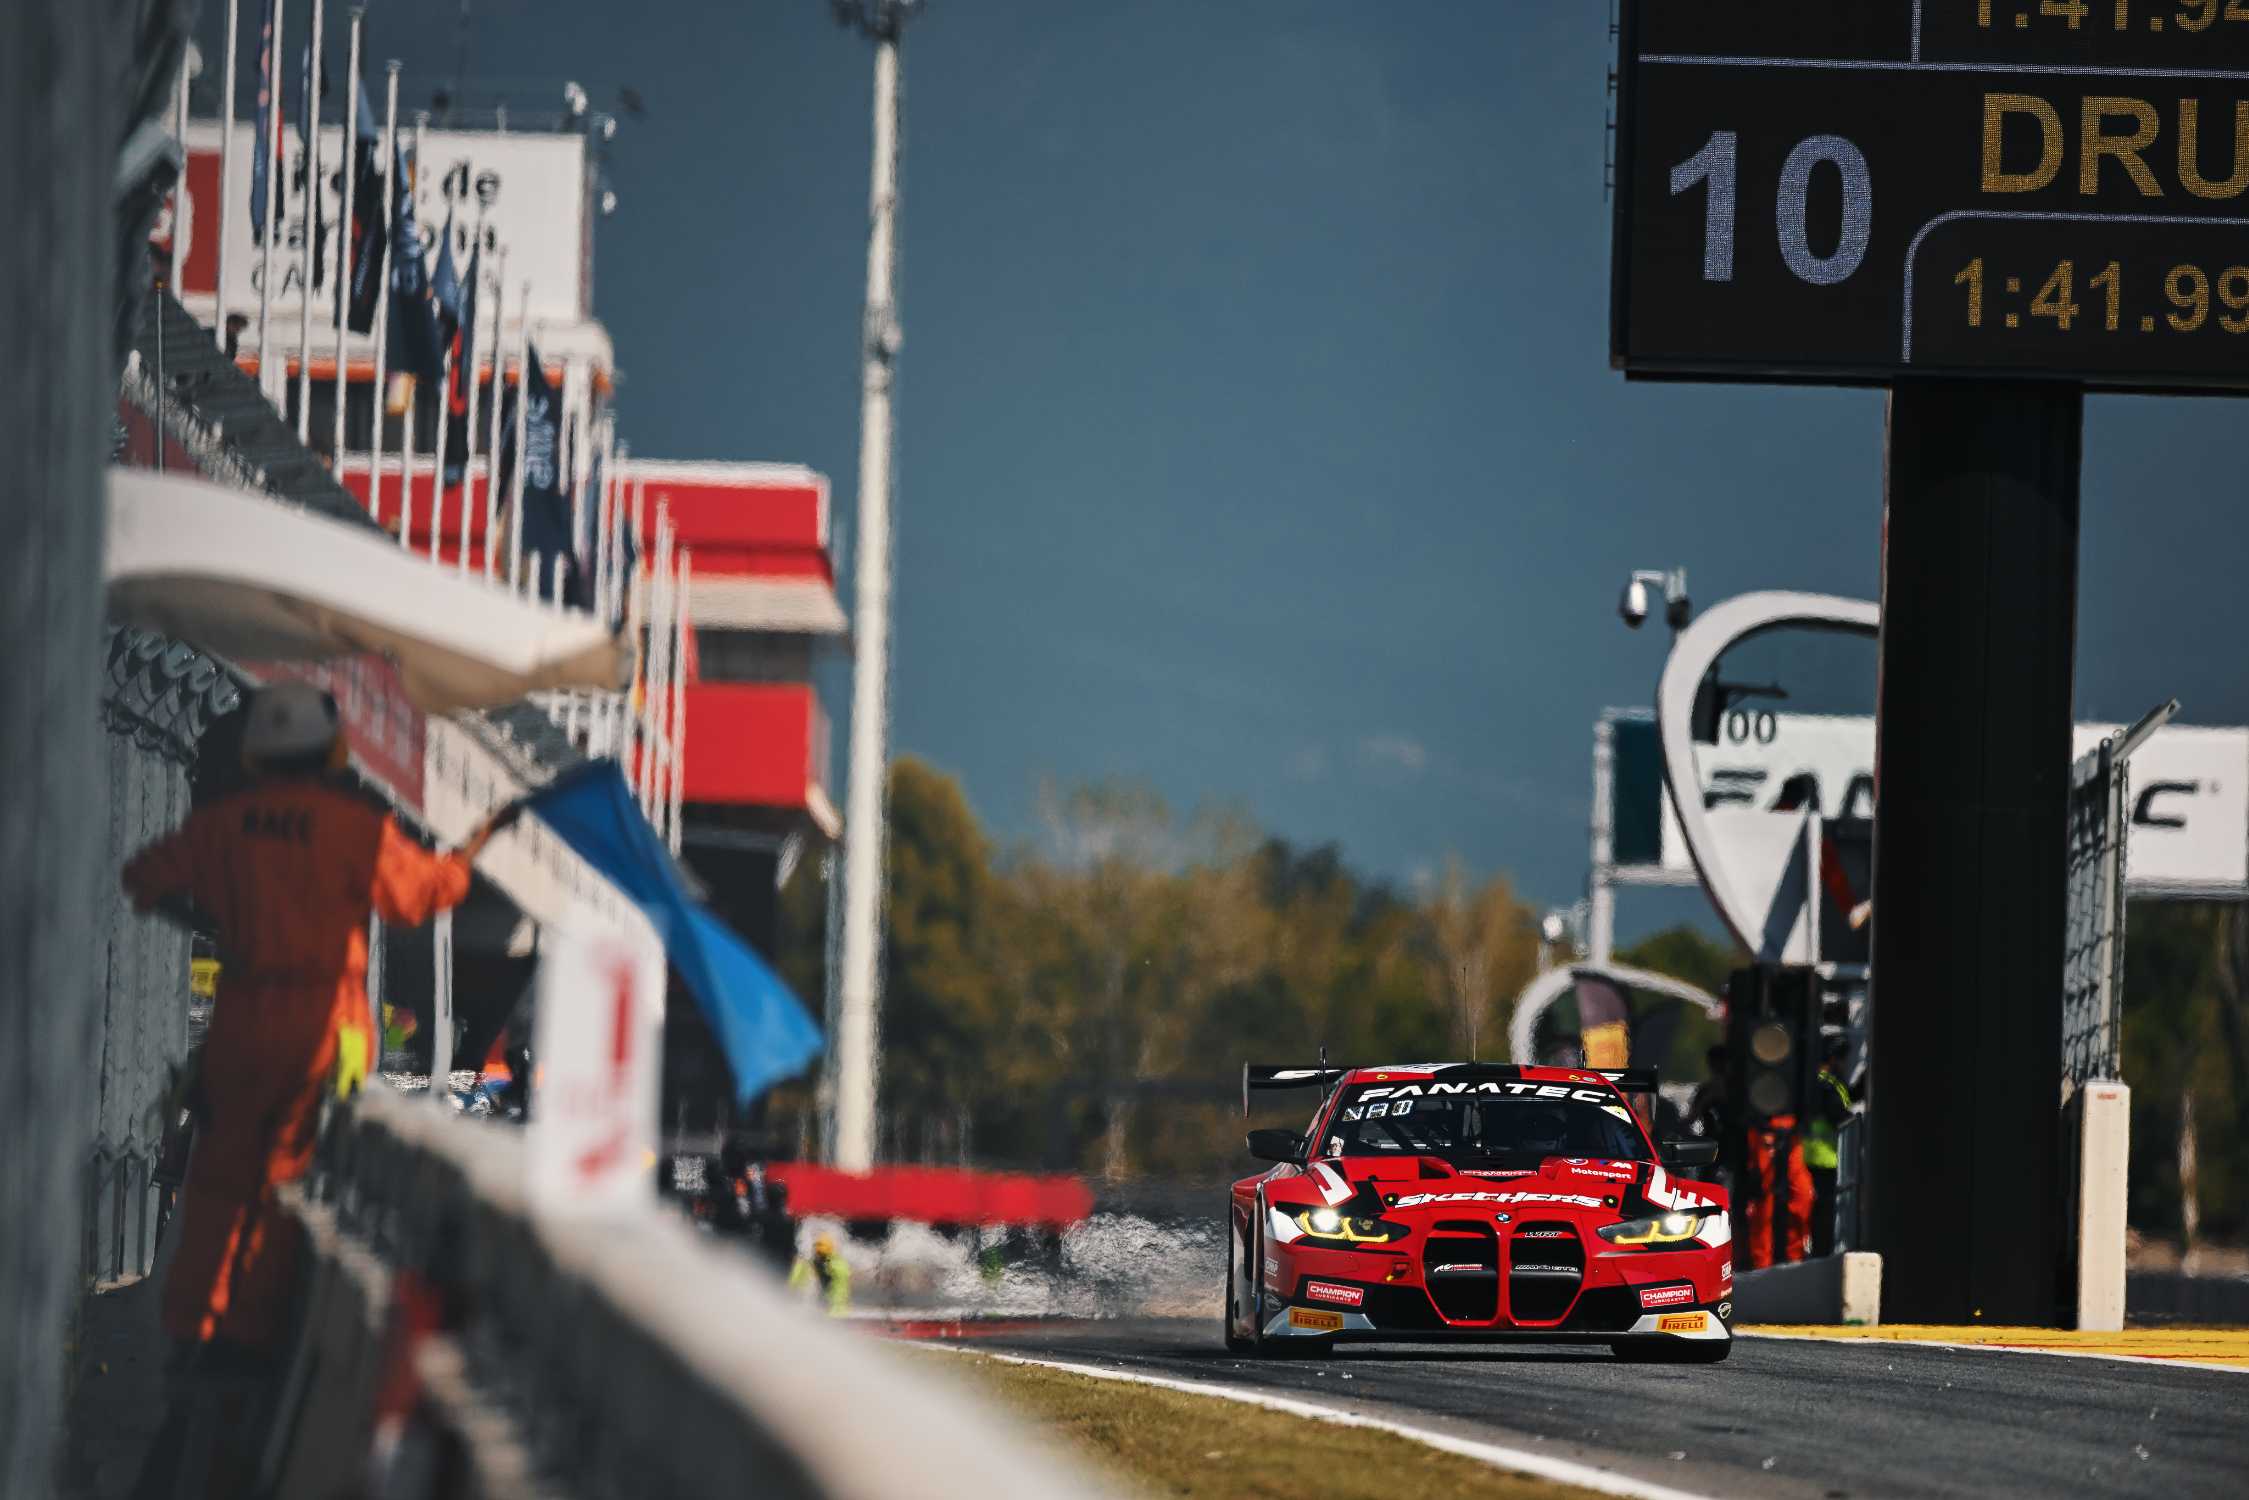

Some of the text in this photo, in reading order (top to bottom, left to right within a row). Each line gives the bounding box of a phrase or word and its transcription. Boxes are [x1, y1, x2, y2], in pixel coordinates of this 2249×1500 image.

[1981, 92, 2249, 199] DRU
[1669, 130, 1873, 286] 10
[1954, 256, 2249, 334] 1:41.99
[1358, 1083, 1607, 1103] FANATEC
[1571, 1167, 1632, 1179] Motorsport
[1395, 1191, 1601, 1209] SKECHERS
[1310, 1285, 1360, 1299] CHAMPION
[1643, 1289, 1691, 1301] CHAMPION
[1294, 1311, 1338, 1328] PIRELLI
[1661, 1315, 1704, 1330] PIRELLI
